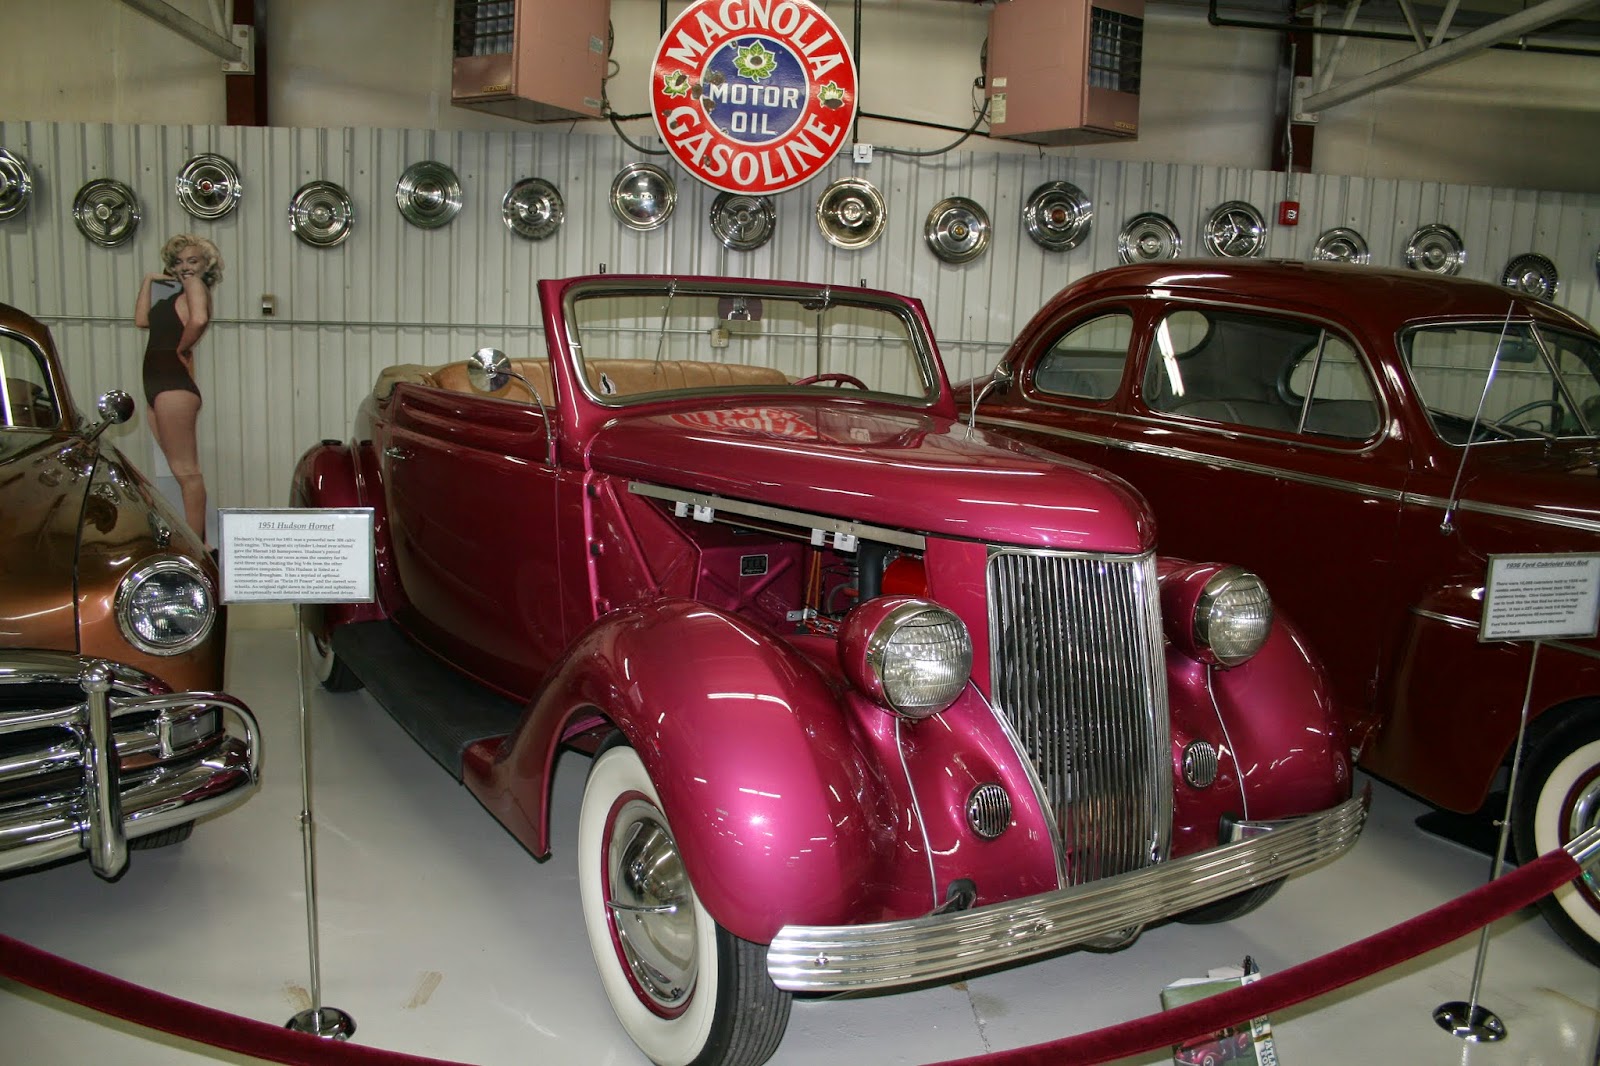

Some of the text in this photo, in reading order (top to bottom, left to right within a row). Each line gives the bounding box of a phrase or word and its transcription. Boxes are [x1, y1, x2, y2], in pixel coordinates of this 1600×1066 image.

[665, 0, 844, 80] MAGNOLIA
[708, 83, 799, 109] MOTOR
[731, 111, 778, 136] OIL
[666, 106, 841, 186] GASOLINE
[258, 521, 335, 531] 1951 Hudson Hornet
[1506, 561, 1521, 570] 1936
[1522, 561, 1535, 569] Ford
[1565, 560, 1576, 568] Hot
[1577, 559, 1589, 567] Rod
